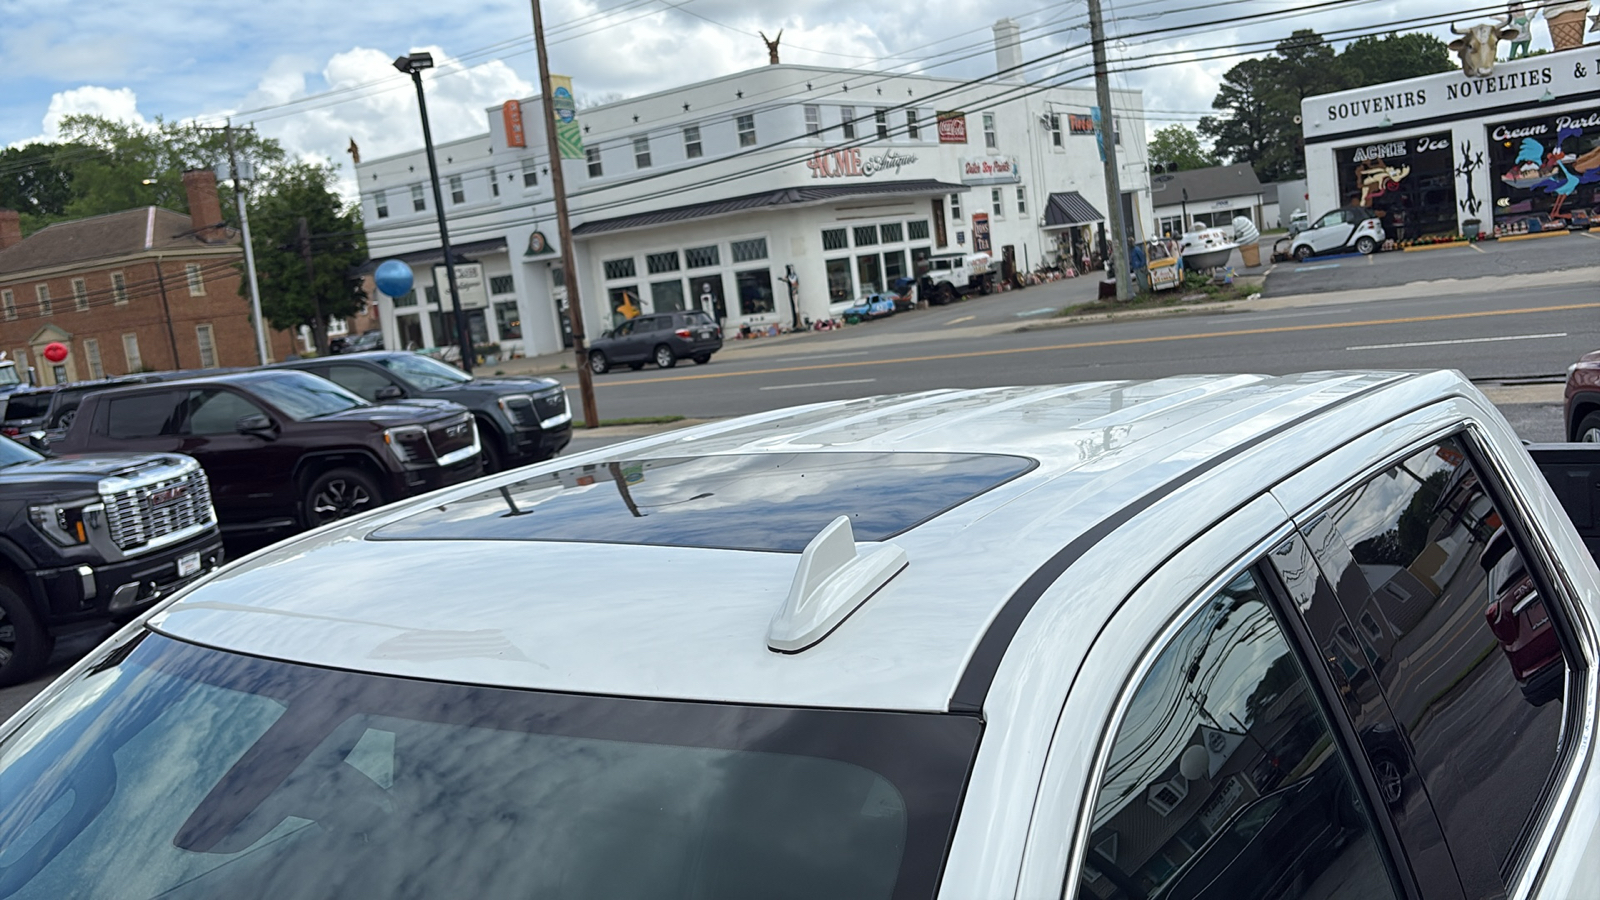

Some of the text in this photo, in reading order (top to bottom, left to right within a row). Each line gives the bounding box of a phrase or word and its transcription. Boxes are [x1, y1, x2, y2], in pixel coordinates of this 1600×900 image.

[1327, 89, 1427, 121] SOUVENIRS
[1446, 67, 1552, 100] NOVELTIES
[1573, 62, 1588, 79] &
[1492, 123, 1548, 141] Cream
[806, 148, 862, 179] ACME
[1352, 137, 1450, 163] ACME Ice
